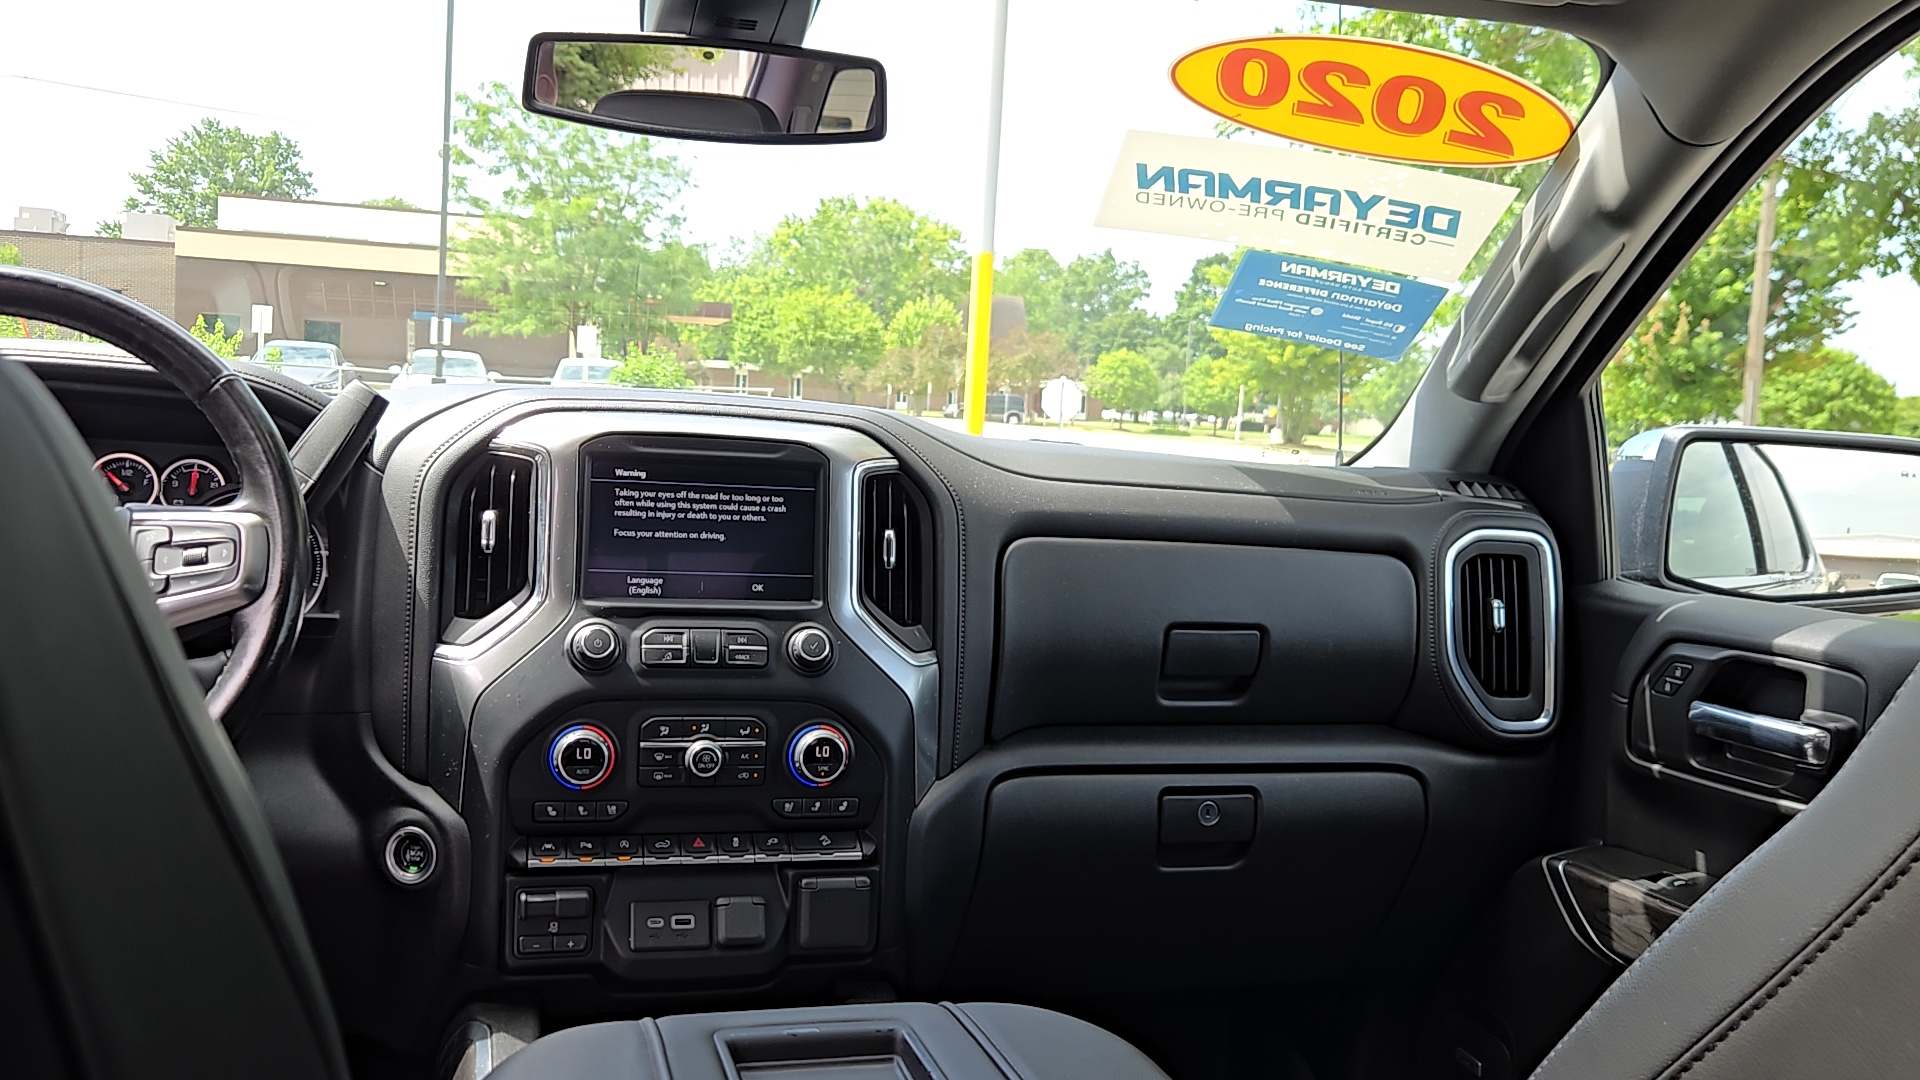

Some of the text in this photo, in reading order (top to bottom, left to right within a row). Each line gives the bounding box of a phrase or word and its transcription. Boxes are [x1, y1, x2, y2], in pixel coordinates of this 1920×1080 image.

[615, 468, 646, 479] Warning
[615, 488, 639, 498] Taking
[640, 490, 656, 499] your
[658, 491, 675, 499] eyes
[676, 490, 687, 499] off
[688, 491, 700, 499] the
[701, 492, 718, 500] road
[720, 492, 730, 500] for
[745, 493, 761, 503] long
[615, 498, 634, 507] often
[636, 499, 655, 507] while
[656, 501, 676, 510] using
[677, 500, 691, 509] this
[692, 501, 717, 511] system
[718, 502, 738, 511] could
[740, 504, 760, 512] cause
[767, 504, 786, 513] crash
[614, 508, 646, 519] resulting
[656, 511, 676, 520] injury
[687, 511, 708, 520] death
[709, 512, 717, 520] to
[718, 514, 731, 522] you
[742, 513, 766, 521] others.
[613, 529, 635, 537] Focus
[636, 530, 653, 538] your
[654, 530, 688, 538] attention
[700, 531, 726, 542] driving.
[627, 575, 663, 586] Language
[628, 585, 662, 596] (English)
[576, 747, 592, 760] LO
[815, 745, 830, 758] LO
